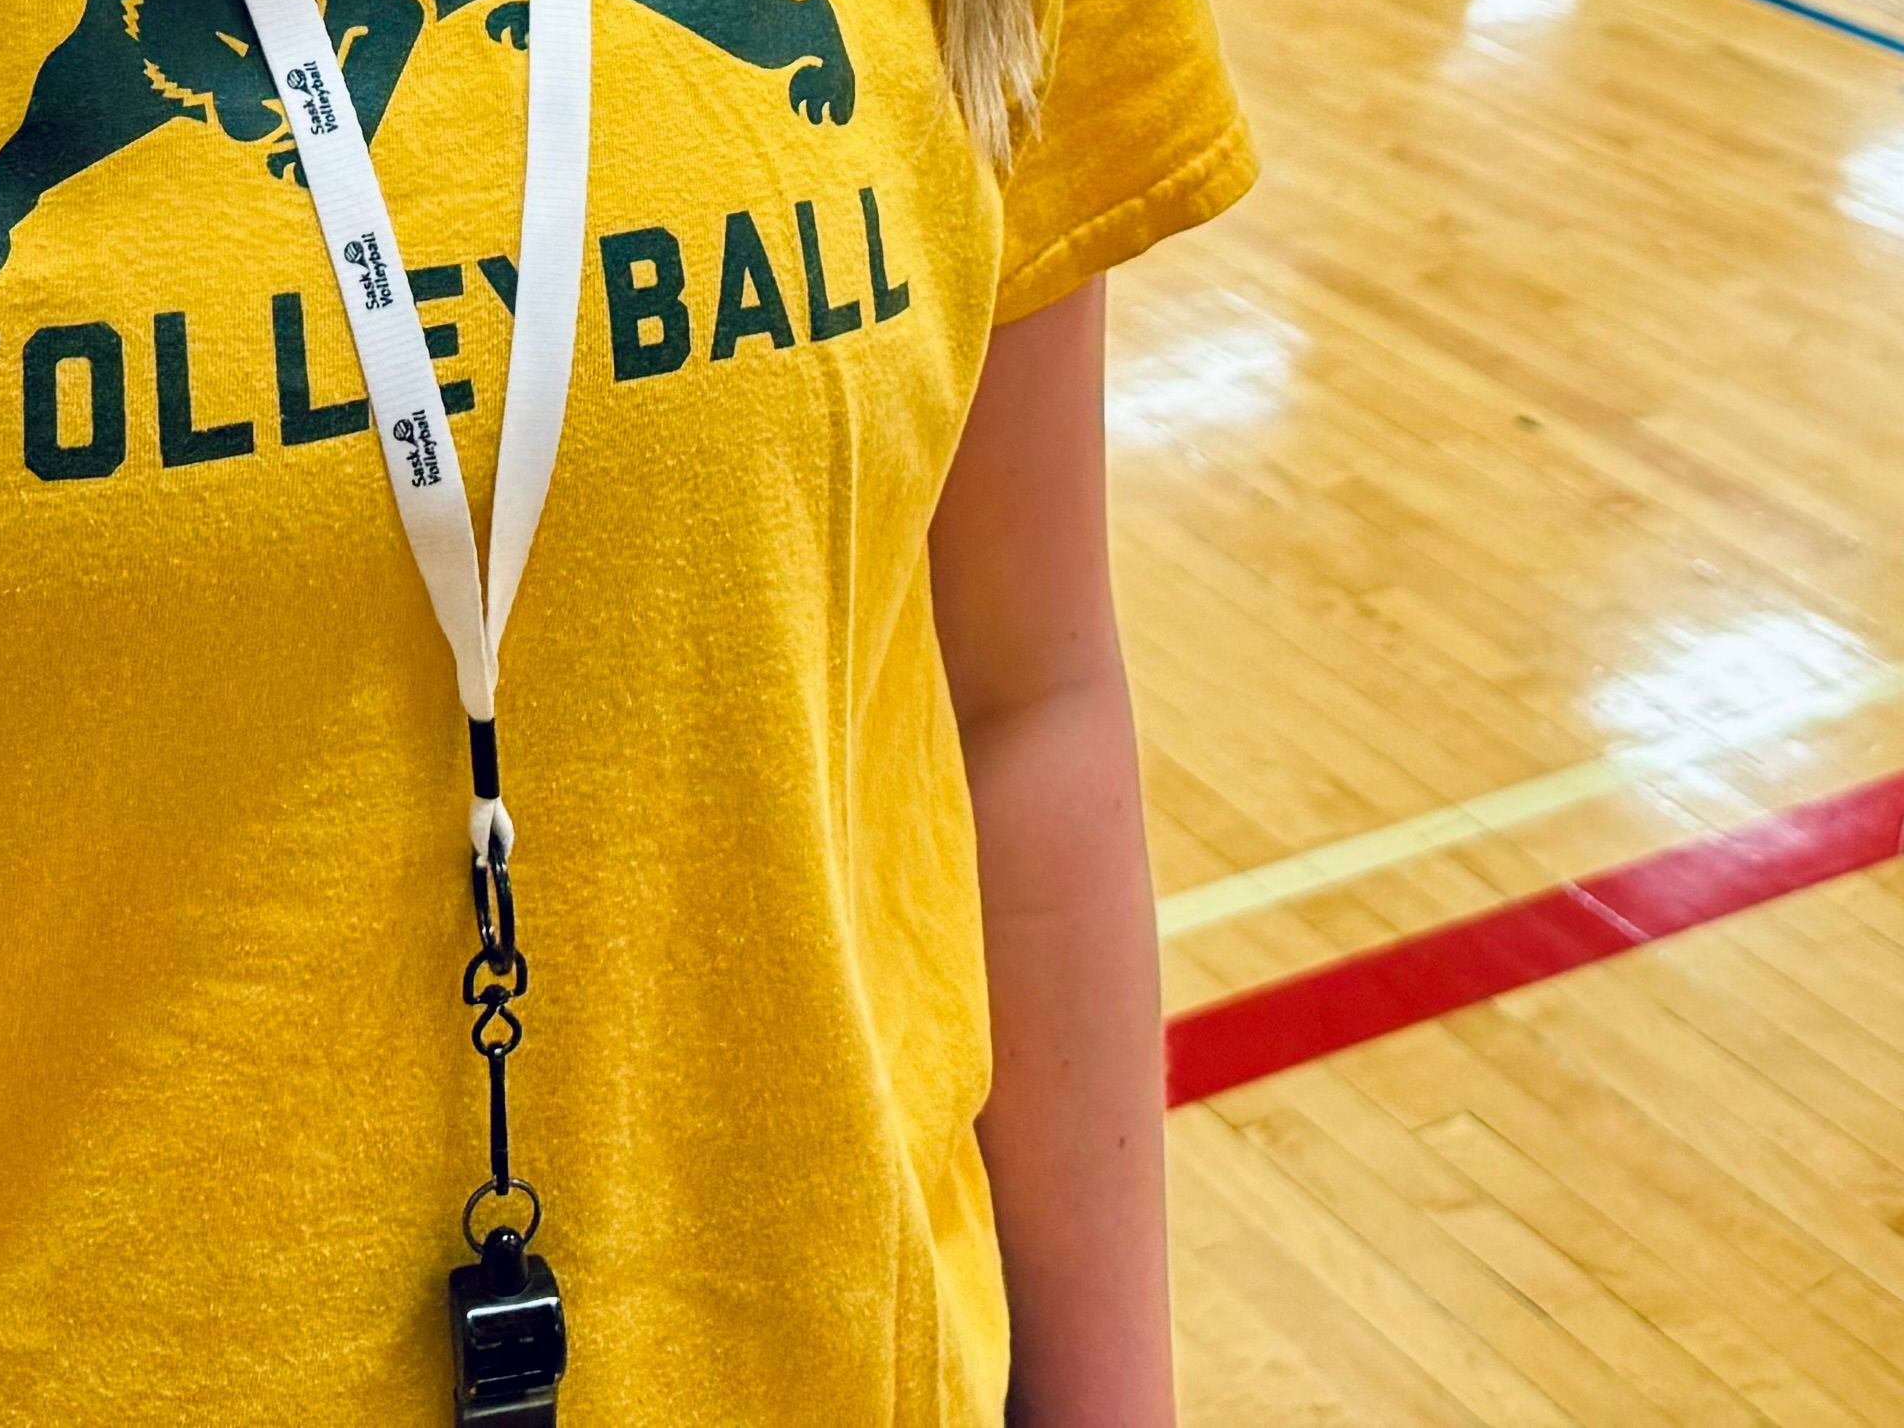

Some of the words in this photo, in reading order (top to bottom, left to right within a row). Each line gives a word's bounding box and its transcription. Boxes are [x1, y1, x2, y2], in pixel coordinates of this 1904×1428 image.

[303, 100, 325, 135] Sask
[304, 61, 339, 134] Volleyball
[359, 272, 380, 310] Sask
[361, 232, 394, 308] Volleyball
[406, 450, 426, 488] Sask
[411, 409, 442, 486] Volleyball
